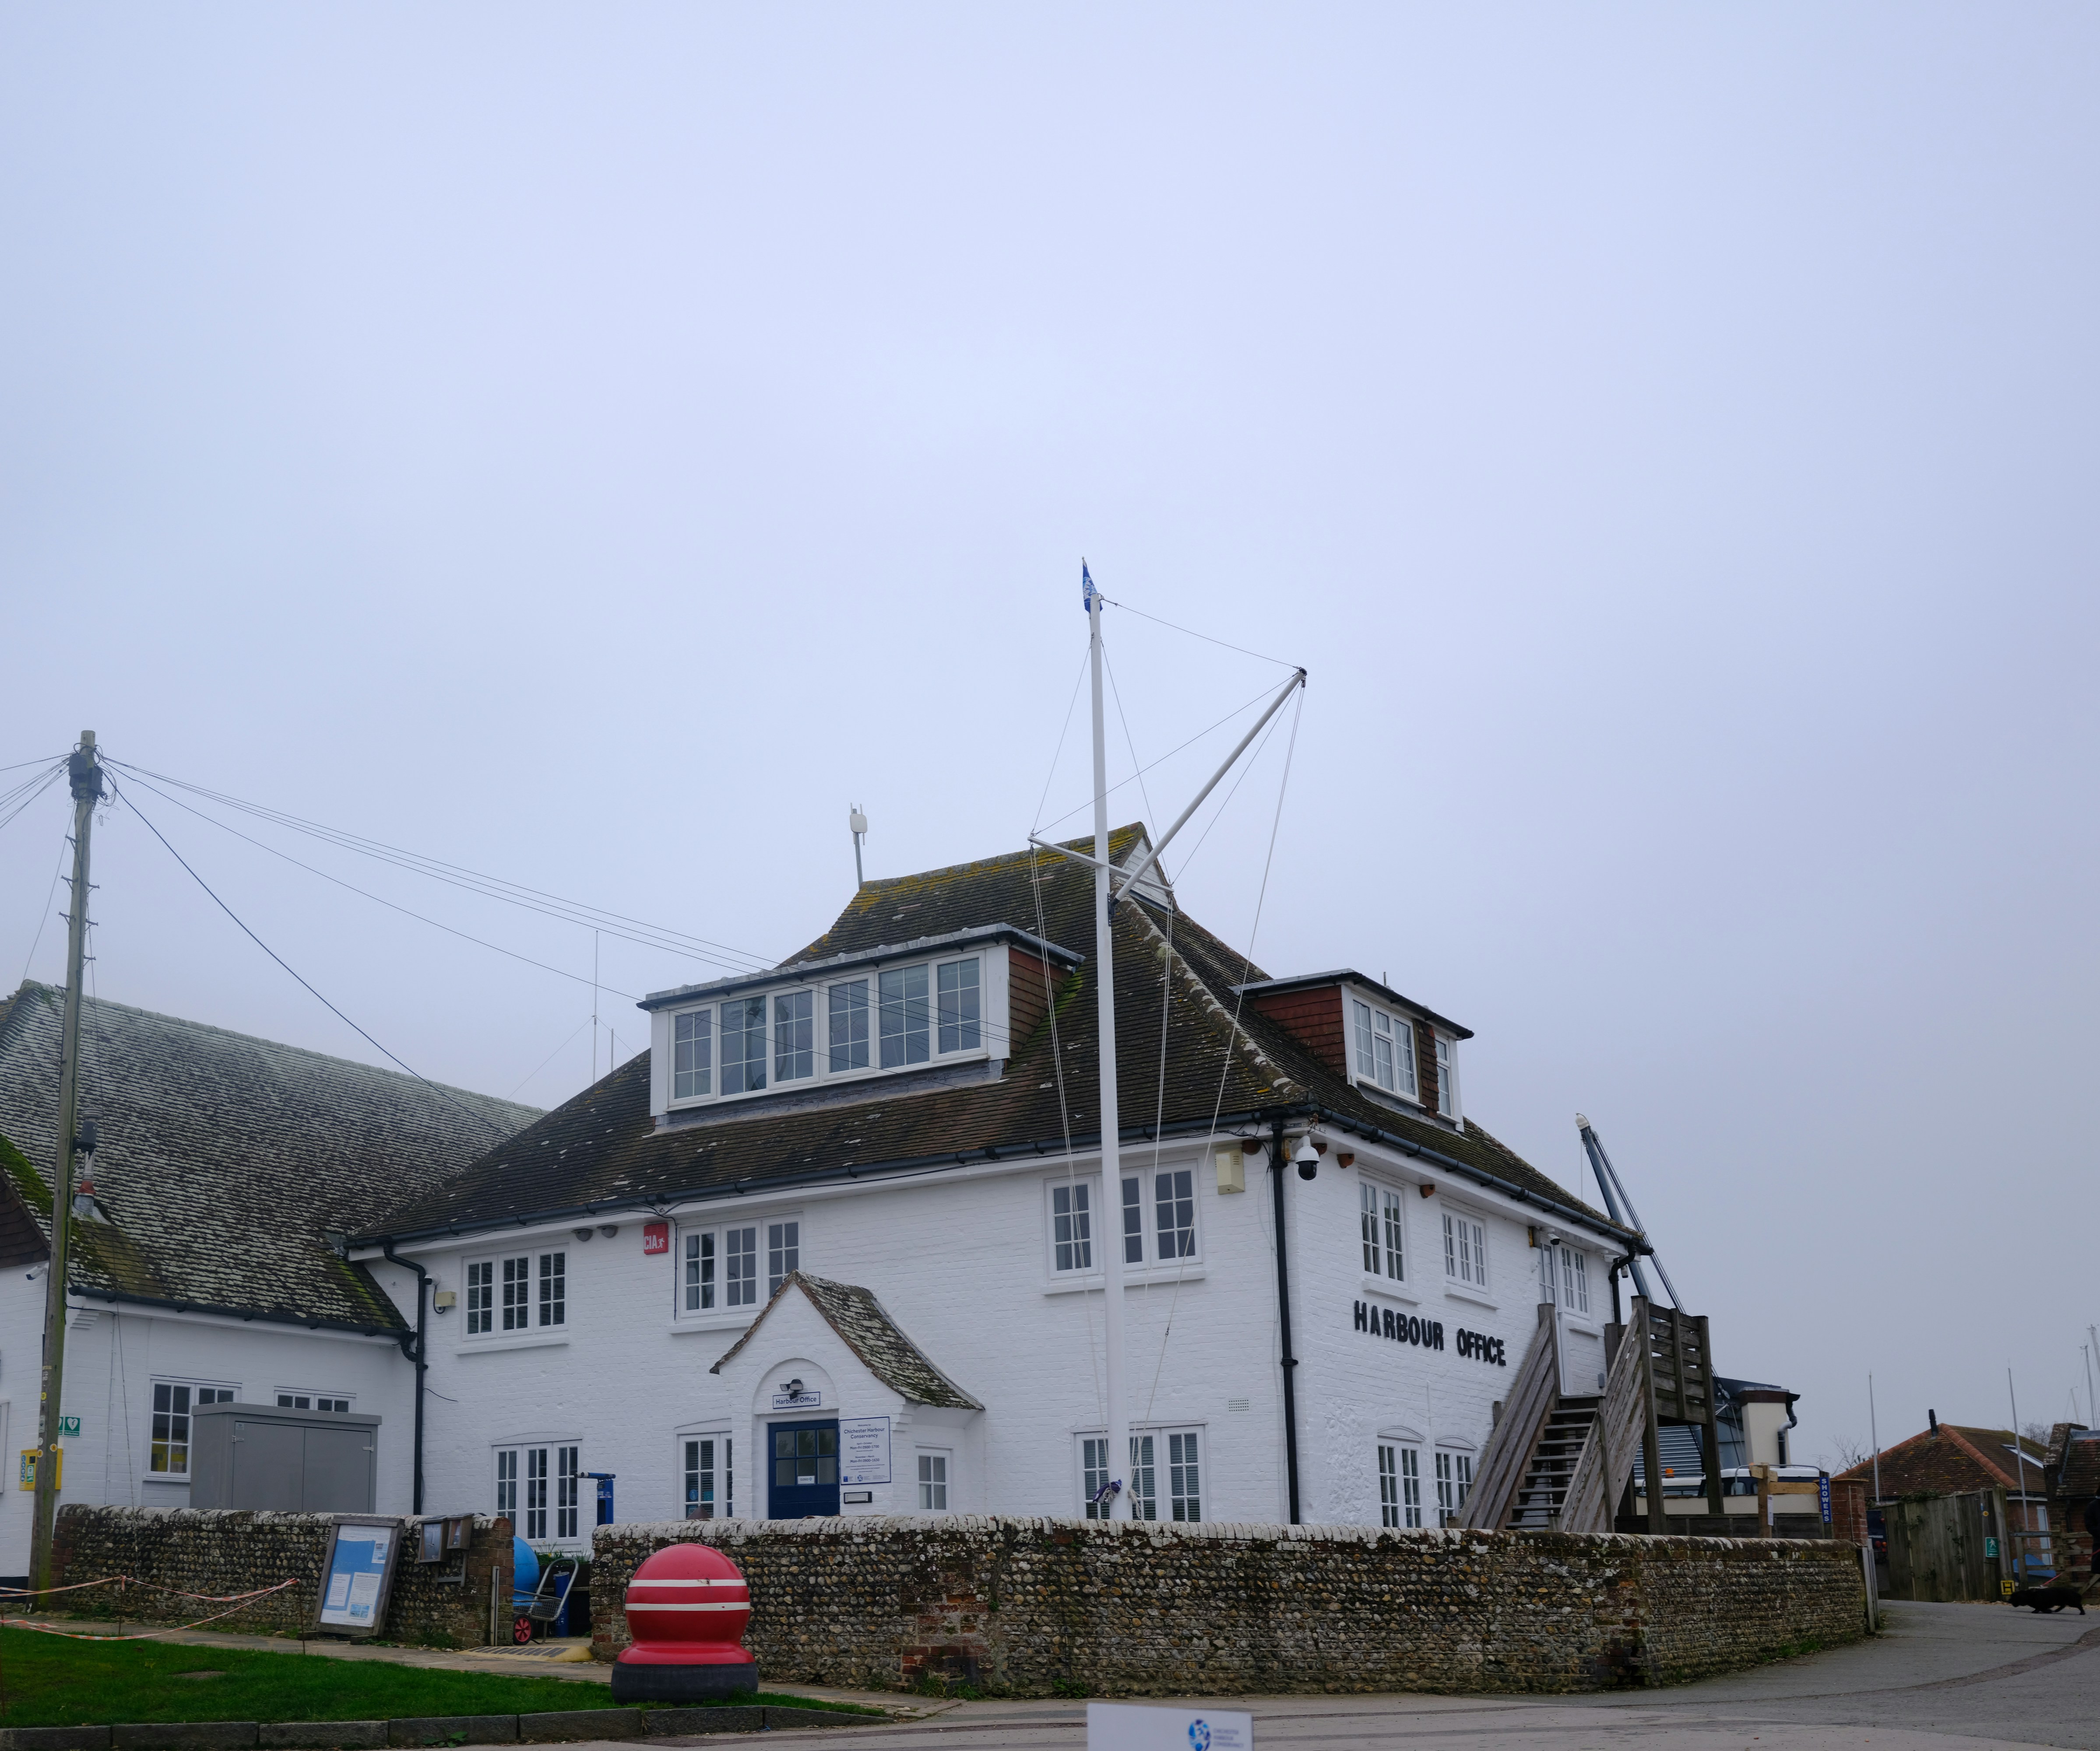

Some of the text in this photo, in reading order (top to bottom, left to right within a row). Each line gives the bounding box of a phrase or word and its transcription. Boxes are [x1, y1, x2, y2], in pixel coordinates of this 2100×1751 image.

[644, 1235, 658, 1250] CIA
[1354, 1300, 1506, 1366] HARBOUR OFFICE
[2003, 1582, 2013, 1593] H
